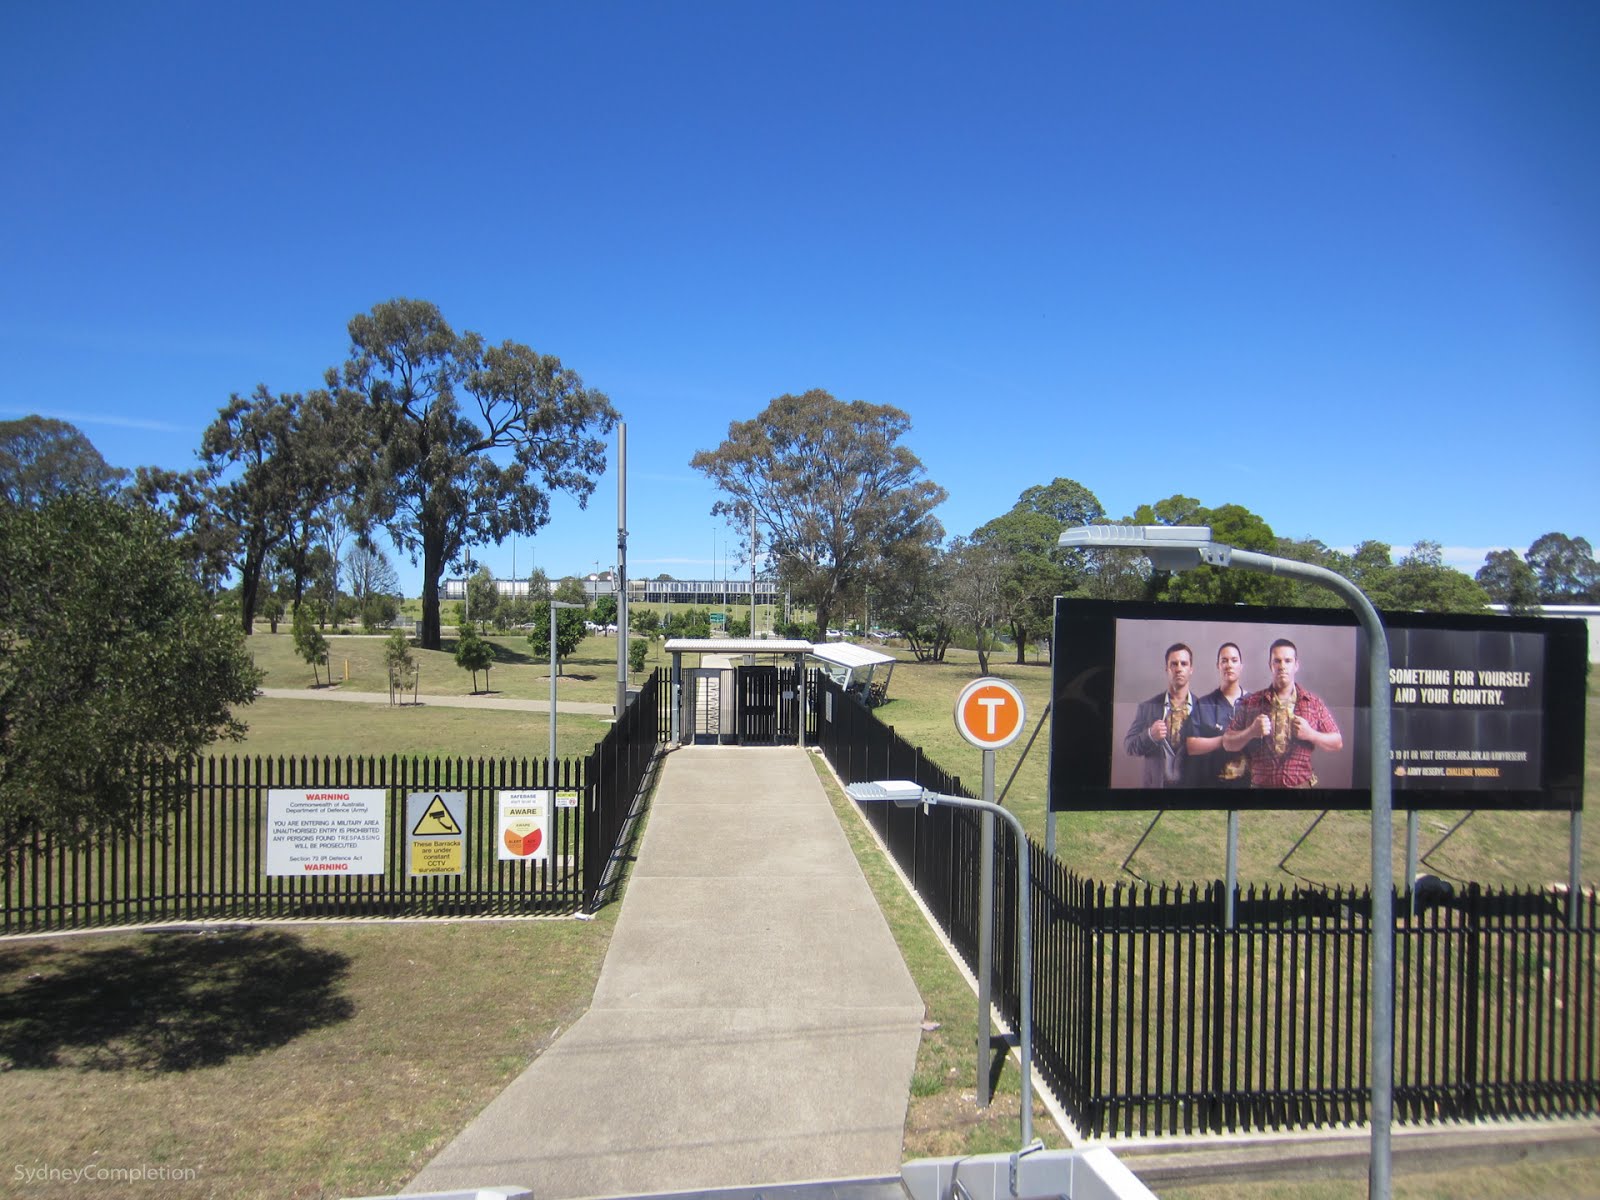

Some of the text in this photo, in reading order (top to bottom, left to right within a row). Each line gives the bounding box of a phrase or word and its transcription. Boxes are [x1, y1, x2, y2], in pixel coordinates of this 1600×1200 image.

[1389, 668, 1531, 687] SOMETHING FOR YOURSELF
[1394, 687, 1505, 705] AND YOUR COUNTRY.
[977, 698, 1006, 735] T
[305, 793, 350, 801] WARNING
[304, 863, 348, 871] WARNING
